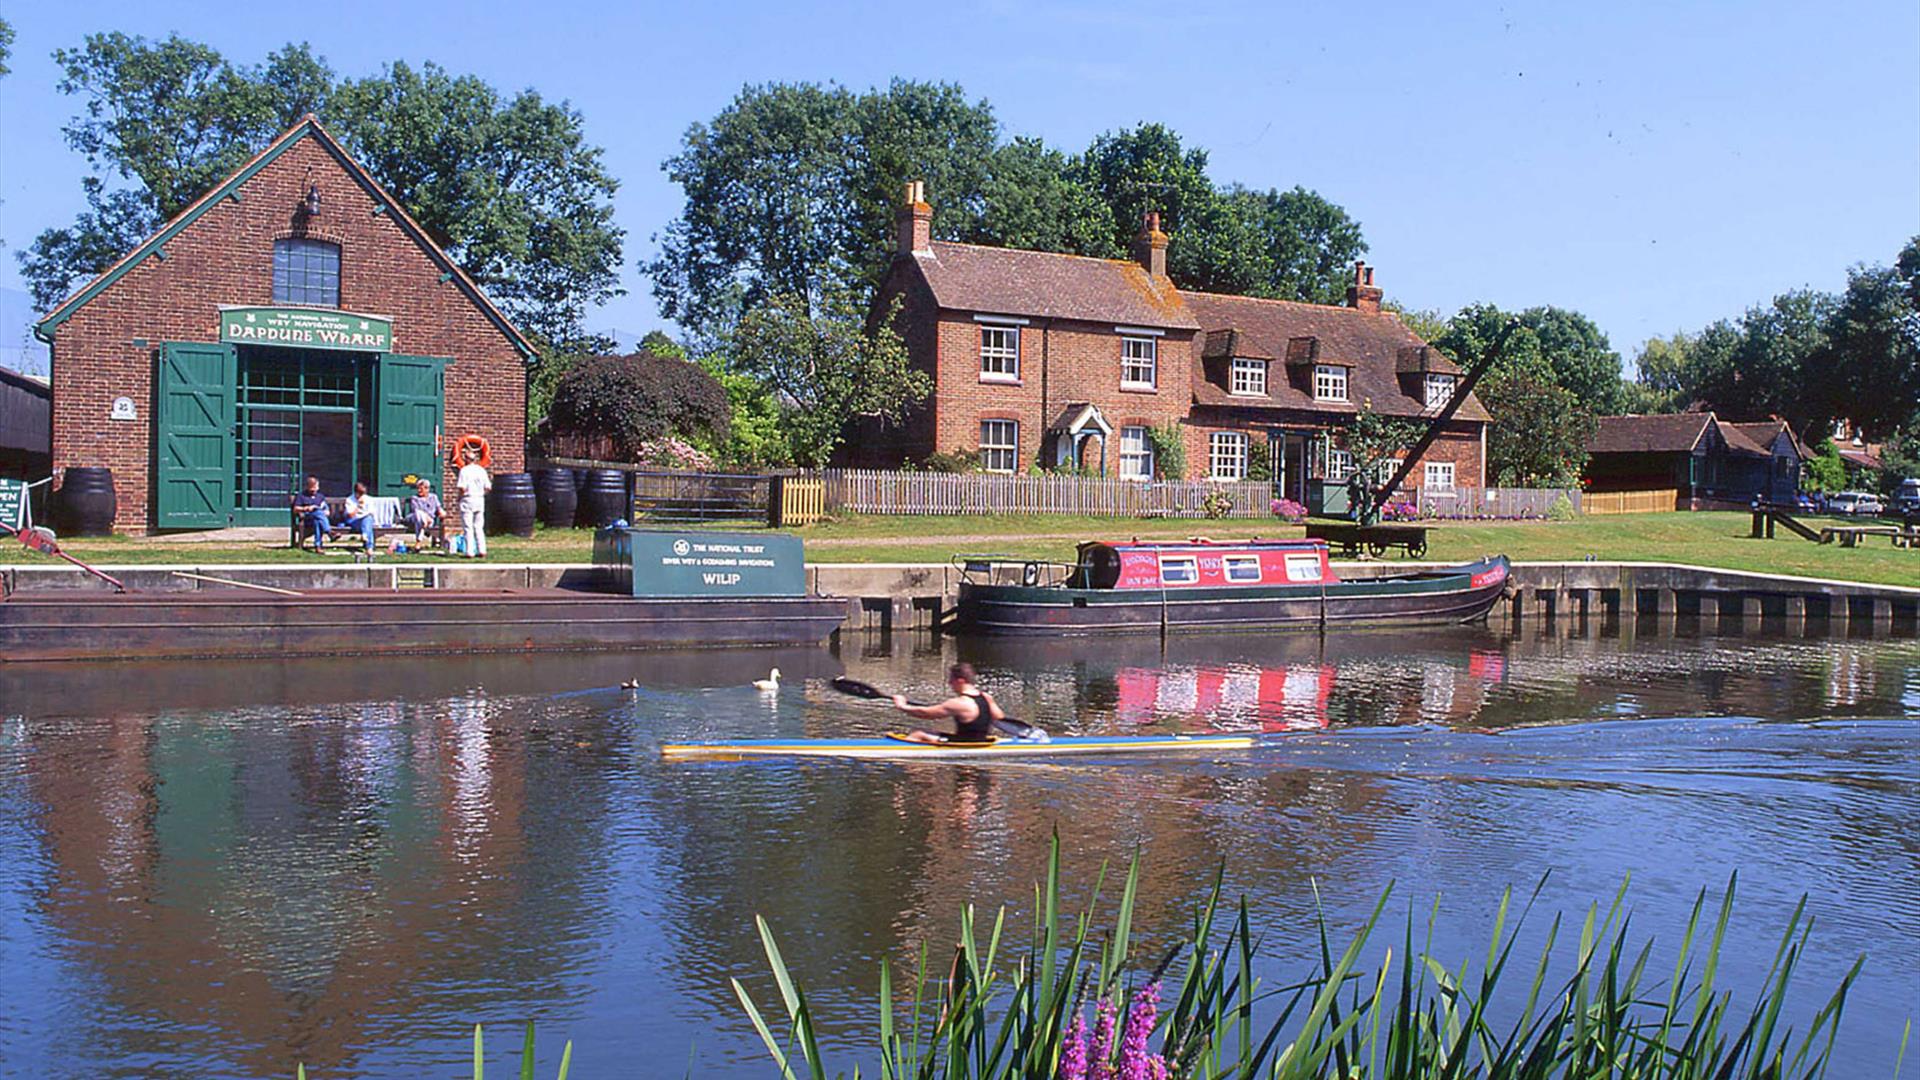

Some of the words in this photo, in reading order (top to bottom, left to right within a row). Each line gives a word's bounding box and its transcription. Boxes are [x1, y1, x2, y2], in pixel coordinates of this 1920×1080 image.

[267, 318, 291, 327] WEY
[294, 320, 349, 330] NAVIGATION
[693, 543, 707, 552] THE
[708, 544, 742, 553] NATIONAL
[742, 545, 765, 553] TRUST
[703, 573, 741, 585] WILIP
